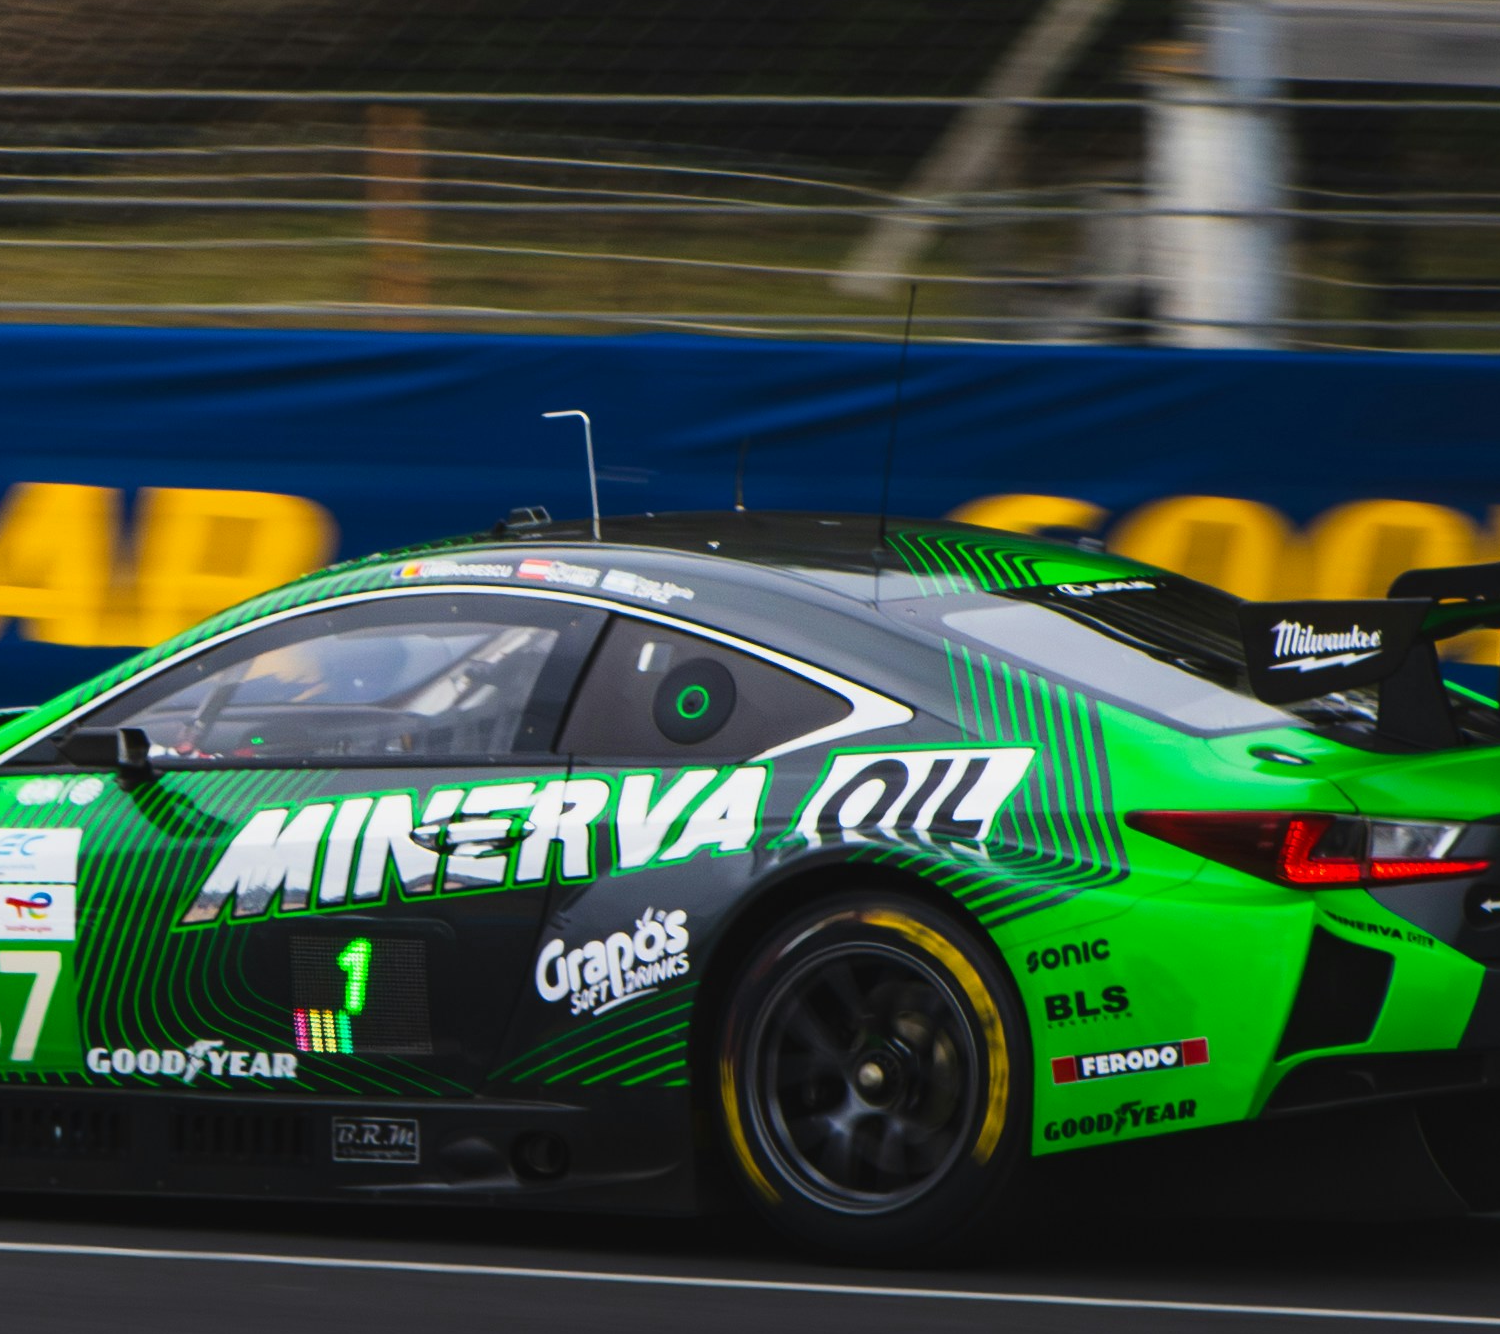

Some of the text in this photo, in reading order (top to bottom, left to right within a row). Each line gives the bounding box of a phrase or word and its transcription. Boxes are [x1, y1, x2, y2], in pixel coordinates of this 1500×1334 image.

[1269, 618, 1382, 658] Milwaukee
[176, 758, 986, 925] MINERVA OIL
[336, 937, 372, 1015] 1
[1026, 938, 1111, 974] SONIC
[570, 952, 691, 1016] SOFT DRINKS
[1044, 985, 1130, 1022] BLS
[86, 1041, 299, 1081] GOODYEAR
[1080, 1045, 1179, 1078] FERODO
[1044, 1098, 1198, 1142] GOODYEAR
